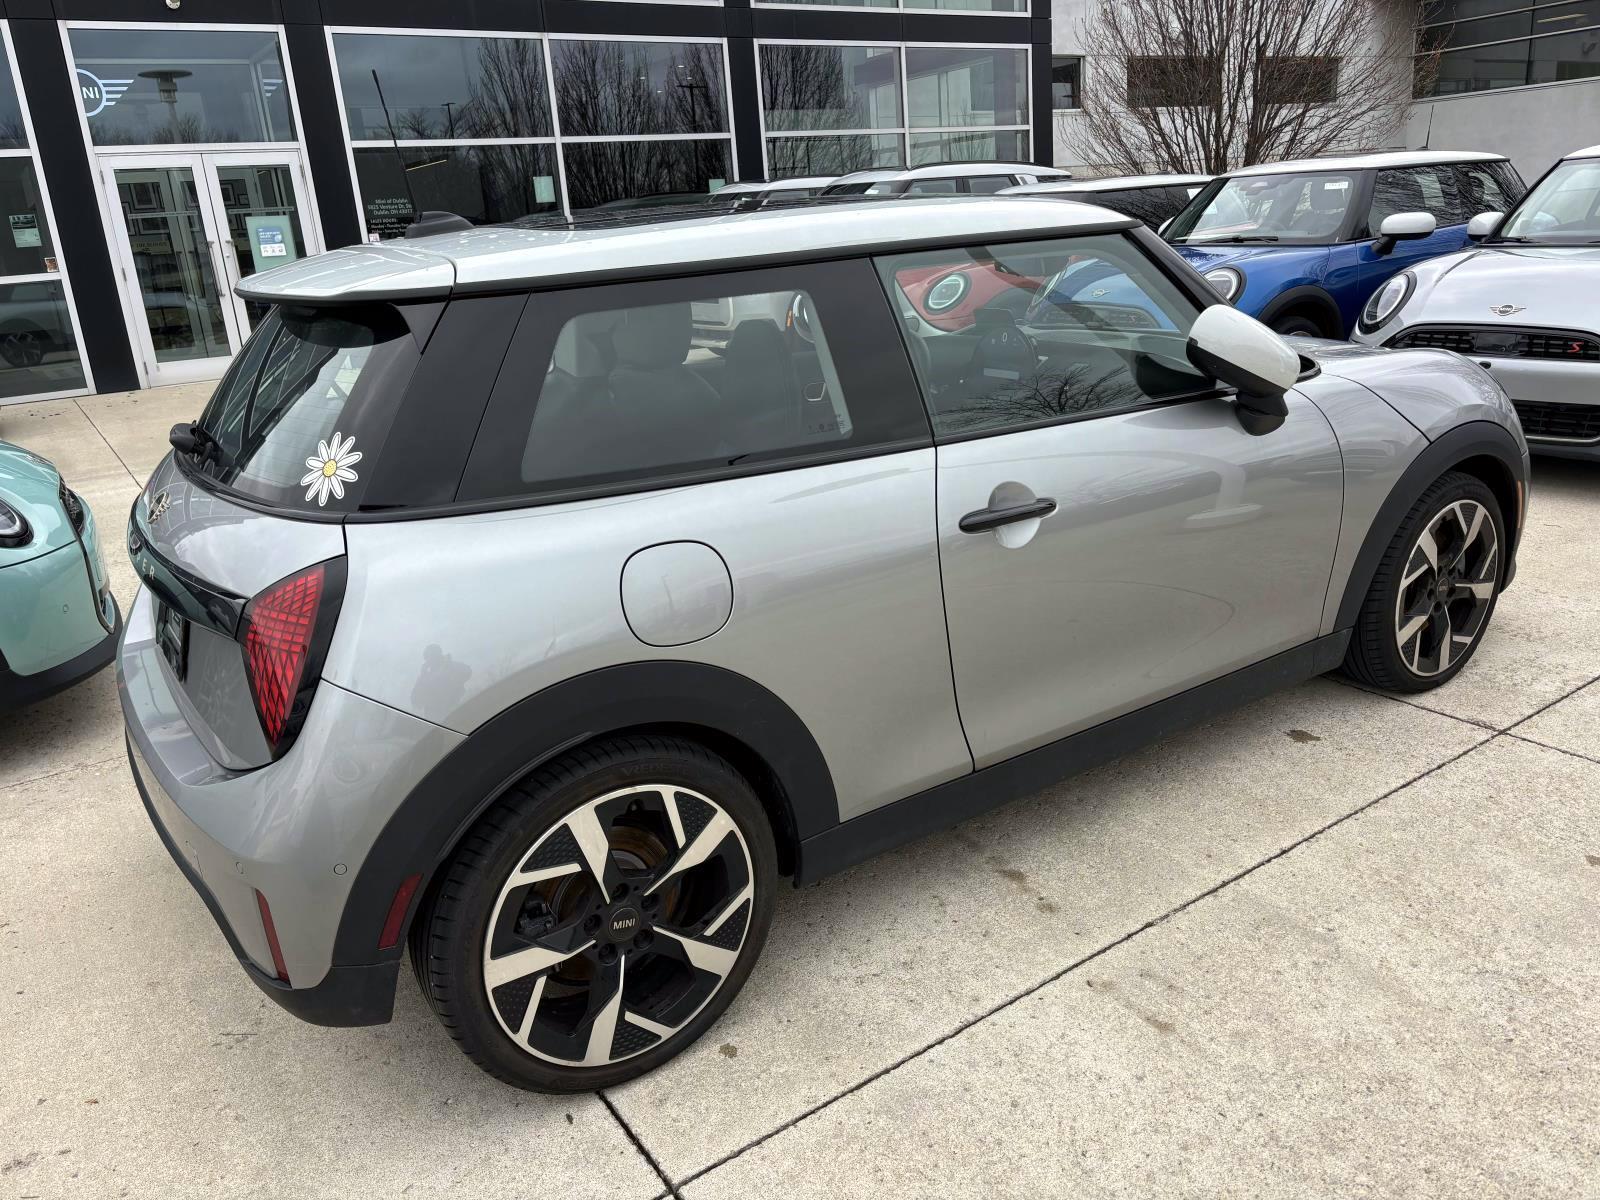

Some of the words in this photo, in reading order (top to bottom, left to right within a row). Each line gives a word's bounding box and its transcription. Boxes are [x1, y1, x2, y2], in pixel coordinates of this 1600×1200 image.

[81, 86, 100, 99] NI
[1567, 341, 1584, 353] S
[613, 918, 636, 930] MINI
